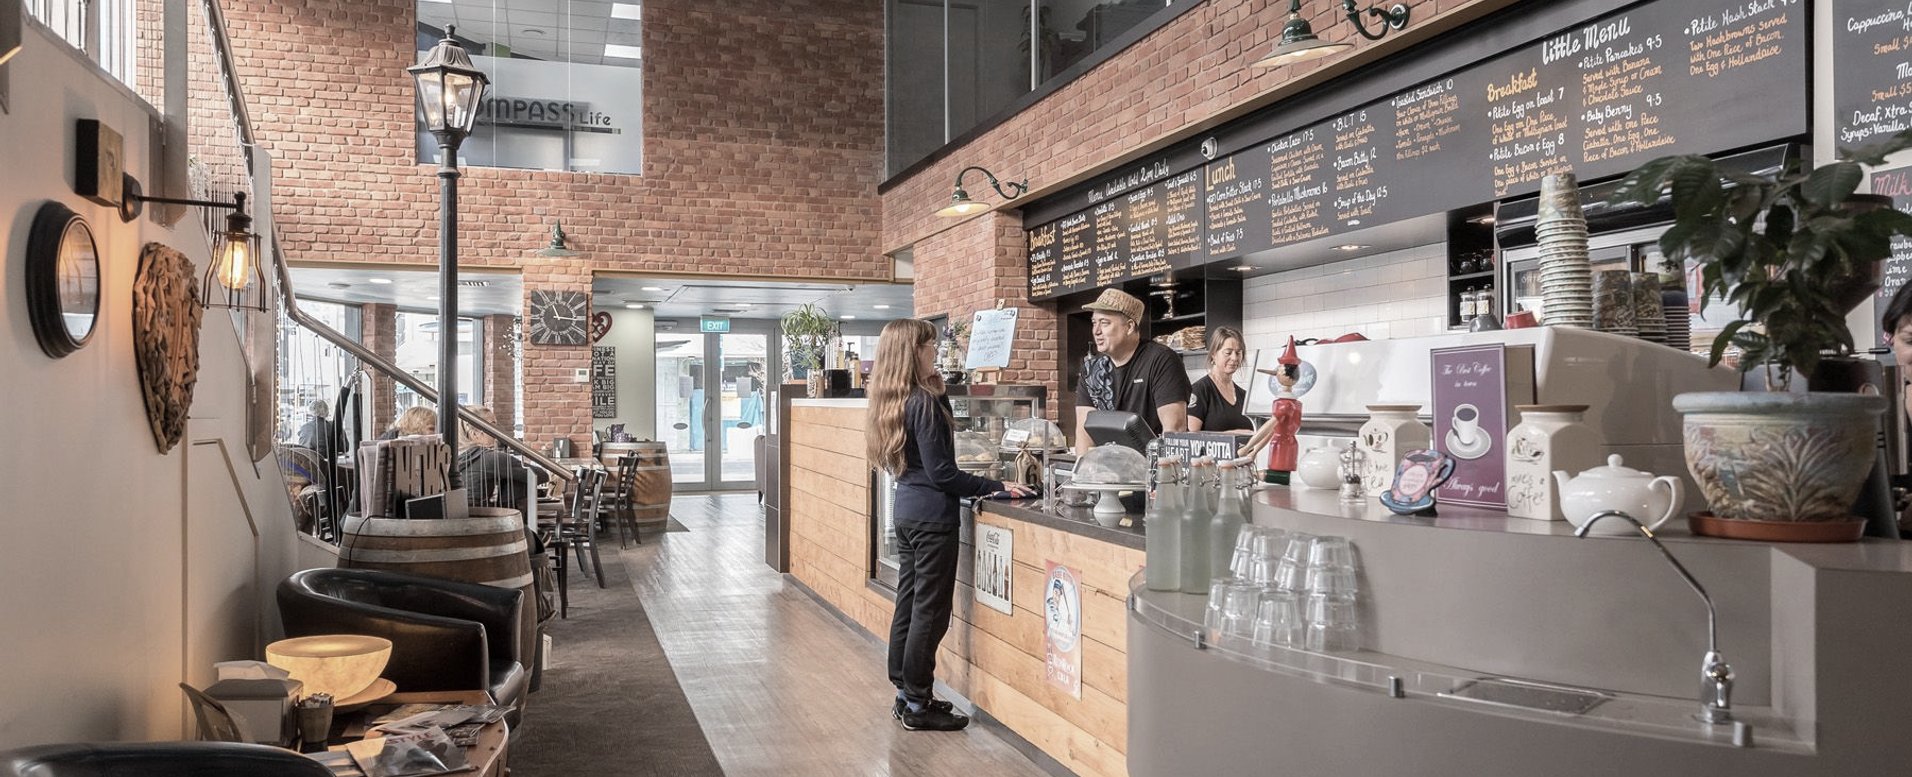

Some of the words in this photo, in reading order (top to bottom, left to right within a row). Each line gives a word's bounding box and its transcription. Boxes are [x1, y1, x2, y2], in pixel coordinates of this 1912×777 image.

[1583, 16, 1630, 50] Menu
[1690, 15, 1718, 36] Petite
[1722, 6, 1747, 26] Hash
[1706, 25, 1756, 48] Hashbrowns
[1706, 48, 1722, 59] One
[1723, 43, 1743, 56] Piece
[1745, 37, 1753, 48] of
[1874, 37, 1900, 55] Small
[1583, 53, 1604, 69] Petite
[1605, 42, 1644, 63] Pancakes
[1583, 70, 1604, 84] Served
[1605, 64, 1620, 77] with
[1622, 57, 1651, 73] Banana
[1588, 81, 1608, 94] Maple
[1610, 76, 1629, 92] Syrup
[1639, 65, 1663, 80] Cream
[1690, 65, 1703, 76] One
[1705, 61, 1719, 77] Egg
[1395, 91, 1415, 109] Toasted
[1416, 81, 1444, 101] Sandwich
[1487, 67, 1538, 102] Breakfast
[1588, 89, 1619, 105] Chocolate
[1620, 84, 1644, 98] Sauce
[1871, 85, 1897, 102] Small
[477, 98, 574, 122] OMPASS
[579, 111, 611, 126] Life
[1493, 105, 1511, 120] Petite
[1512, 101, 1525, 119] Egg
[1526, 101, 1535, 110] on
[1558, 87, 1564, 100] 7
[1584, 125, 1607, 139] Served
[1607, 120, 1623, 133] with
[1641, 112, 1659, 126] Piece
[1586, 108, 1604, 125] Baby
[1494, 146, 1513, 161] Petite
[1514, 143, 1535, 156] Bacon
[1542, 138, 1556, 156] Egg
[1558, 133, 1565, 145] 8
[1583, 152, 1600, 163] Piece
[1601, 148, 1608, 159] of
[1609, 146, 1630, 158] Bacon
[1206, 156, 1236, 192] Lunch
[1874, 171, 1912, 197] Milk
[707, 321, 724, 330] EXIT
[593, 365, 615, 377] FE
[595, 397, 615, 406] ILE
[1165, 445, 1190, 462] HEART
[1206, 441, 1231, 459] GOTTA
[1478, 481, 1500, 498] good
